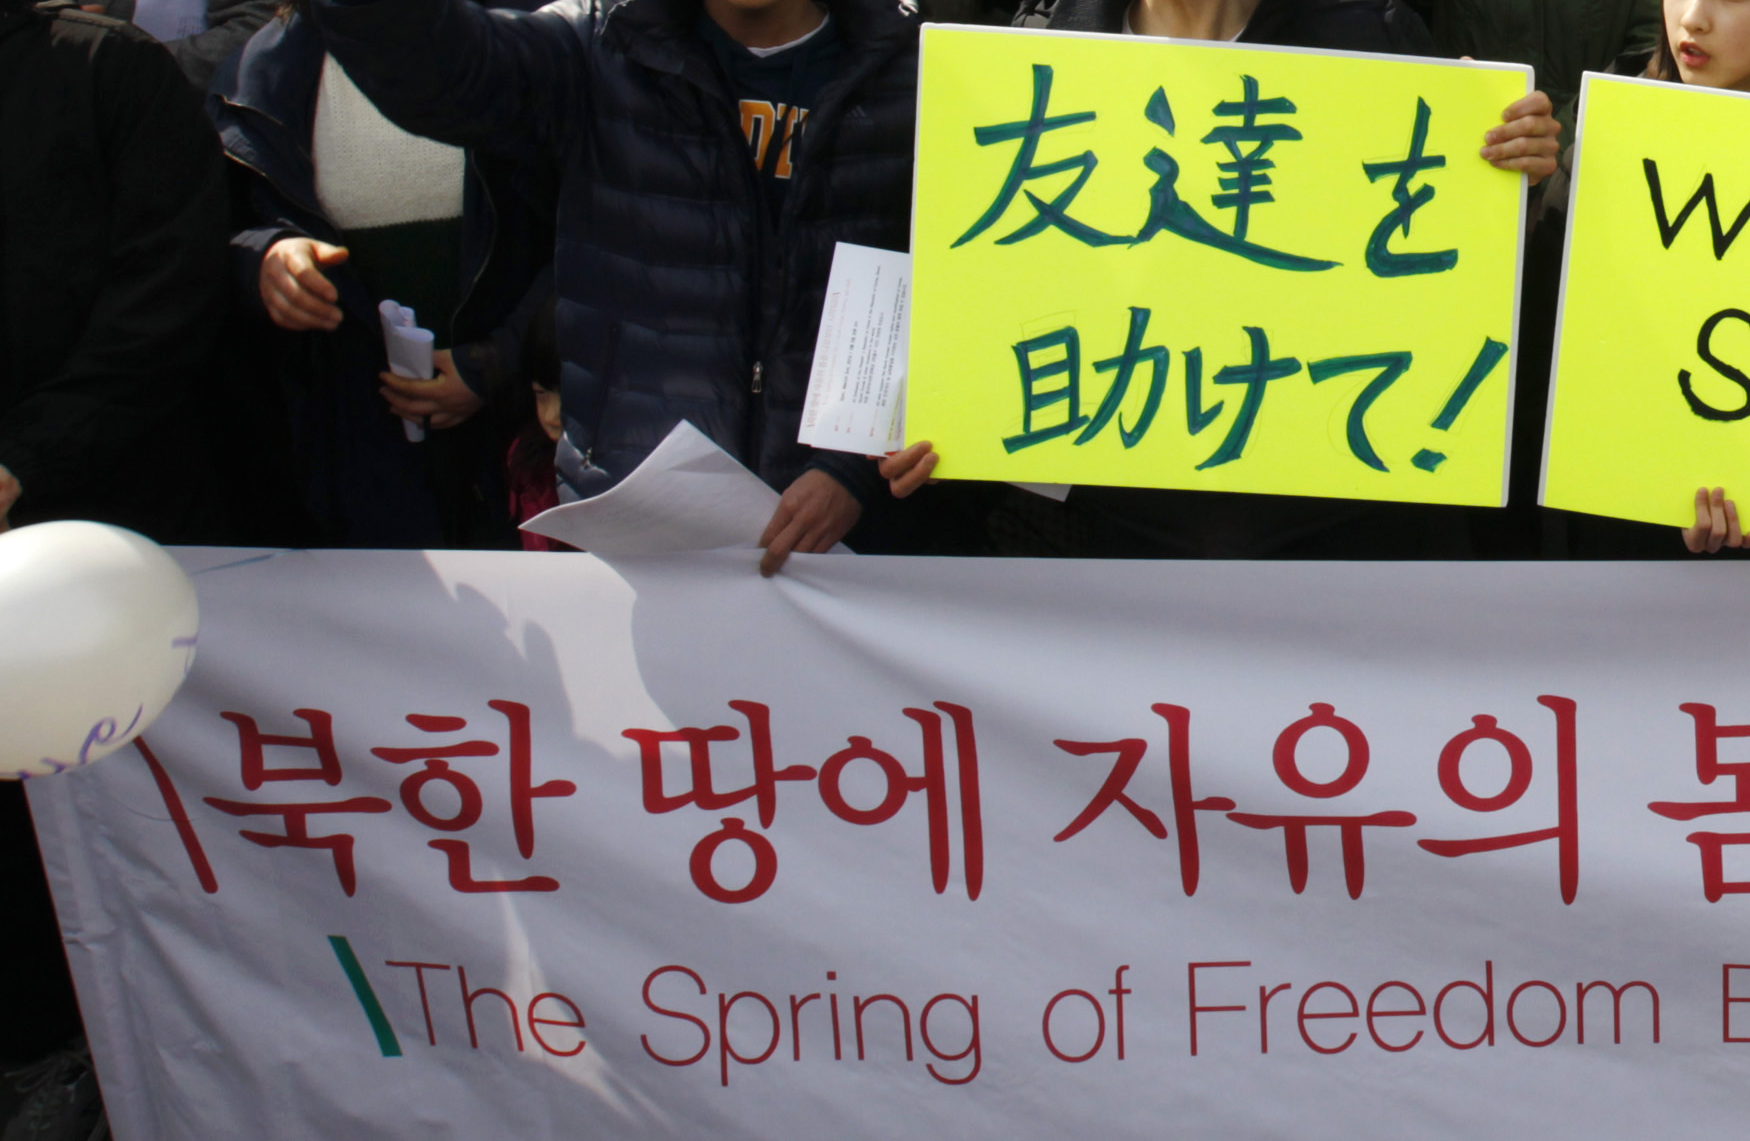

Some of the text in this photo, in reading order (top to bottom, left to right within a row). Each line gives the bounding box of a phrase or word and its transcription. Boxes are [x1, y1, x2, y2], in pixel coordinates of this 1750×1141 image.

[950, 63, 1460, 278] 友達を
[203, 698, 577, 898] 북한
[620, 699, 985, 905] 땅에
[1052, 694, 1578, 905] 자유의
[384, 959, 588, 1057] The
[640, 964, 983, 1088] Spring
[1042, 964, 1133, 1063] of
[1187, 959, 1662, 1057] Freedom
